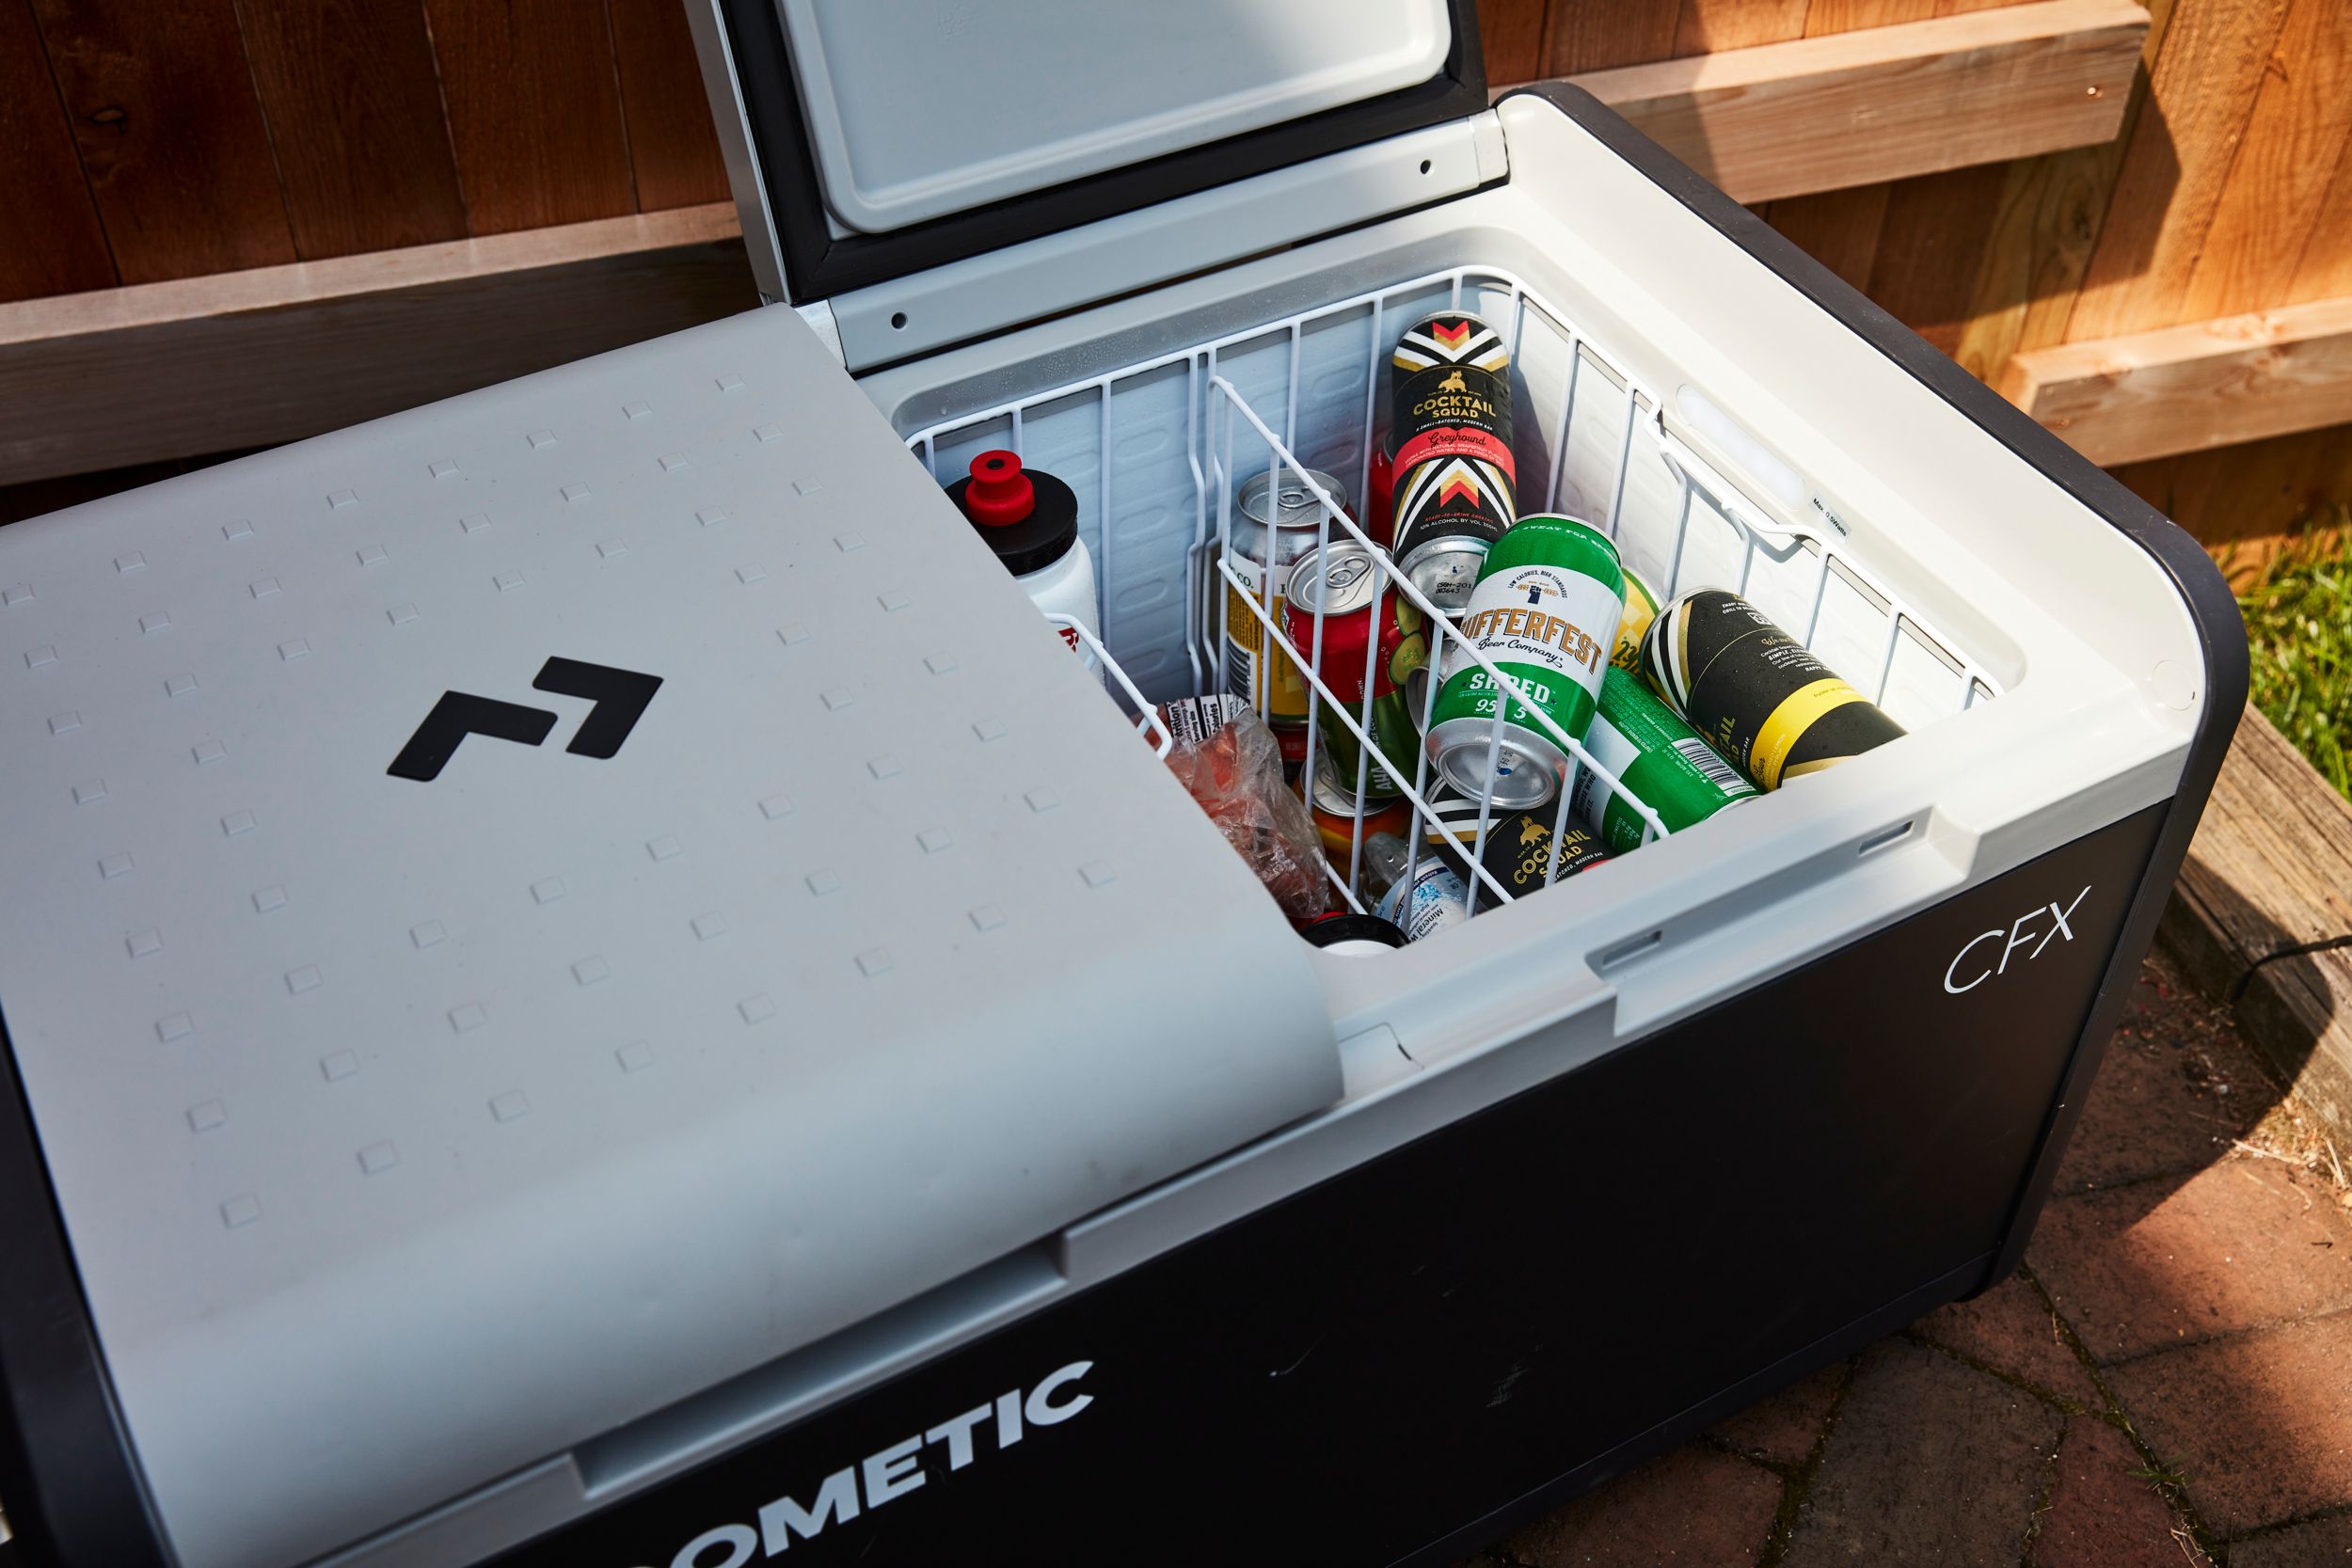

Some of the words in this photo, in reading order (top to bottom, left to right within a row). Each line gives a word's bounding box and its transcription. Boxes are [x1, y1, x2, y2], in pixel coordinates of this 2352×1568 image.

[1413, 395, 1497, 418] COCKTAIL
[1432, 407, 1478, 419] SQUAD
[1428, 432, 1486, 449] Greyhound
[1430, 517, 1458, 526] ALCOHOL
[1476, 635, 1505, 650] Beer
[1507, 639, 1563, 669] Company
[1514, 830, 1591, 884] COCKAIL
[1539, 846, 1582, 878] SUAD
[1575, 854, 1594, 865] MODERN
[1416, 908, 1444, 936] Mineral
[1944, 884, 2092, 994] CFX
[628, 1360, 1094, 1568] OMETIC
